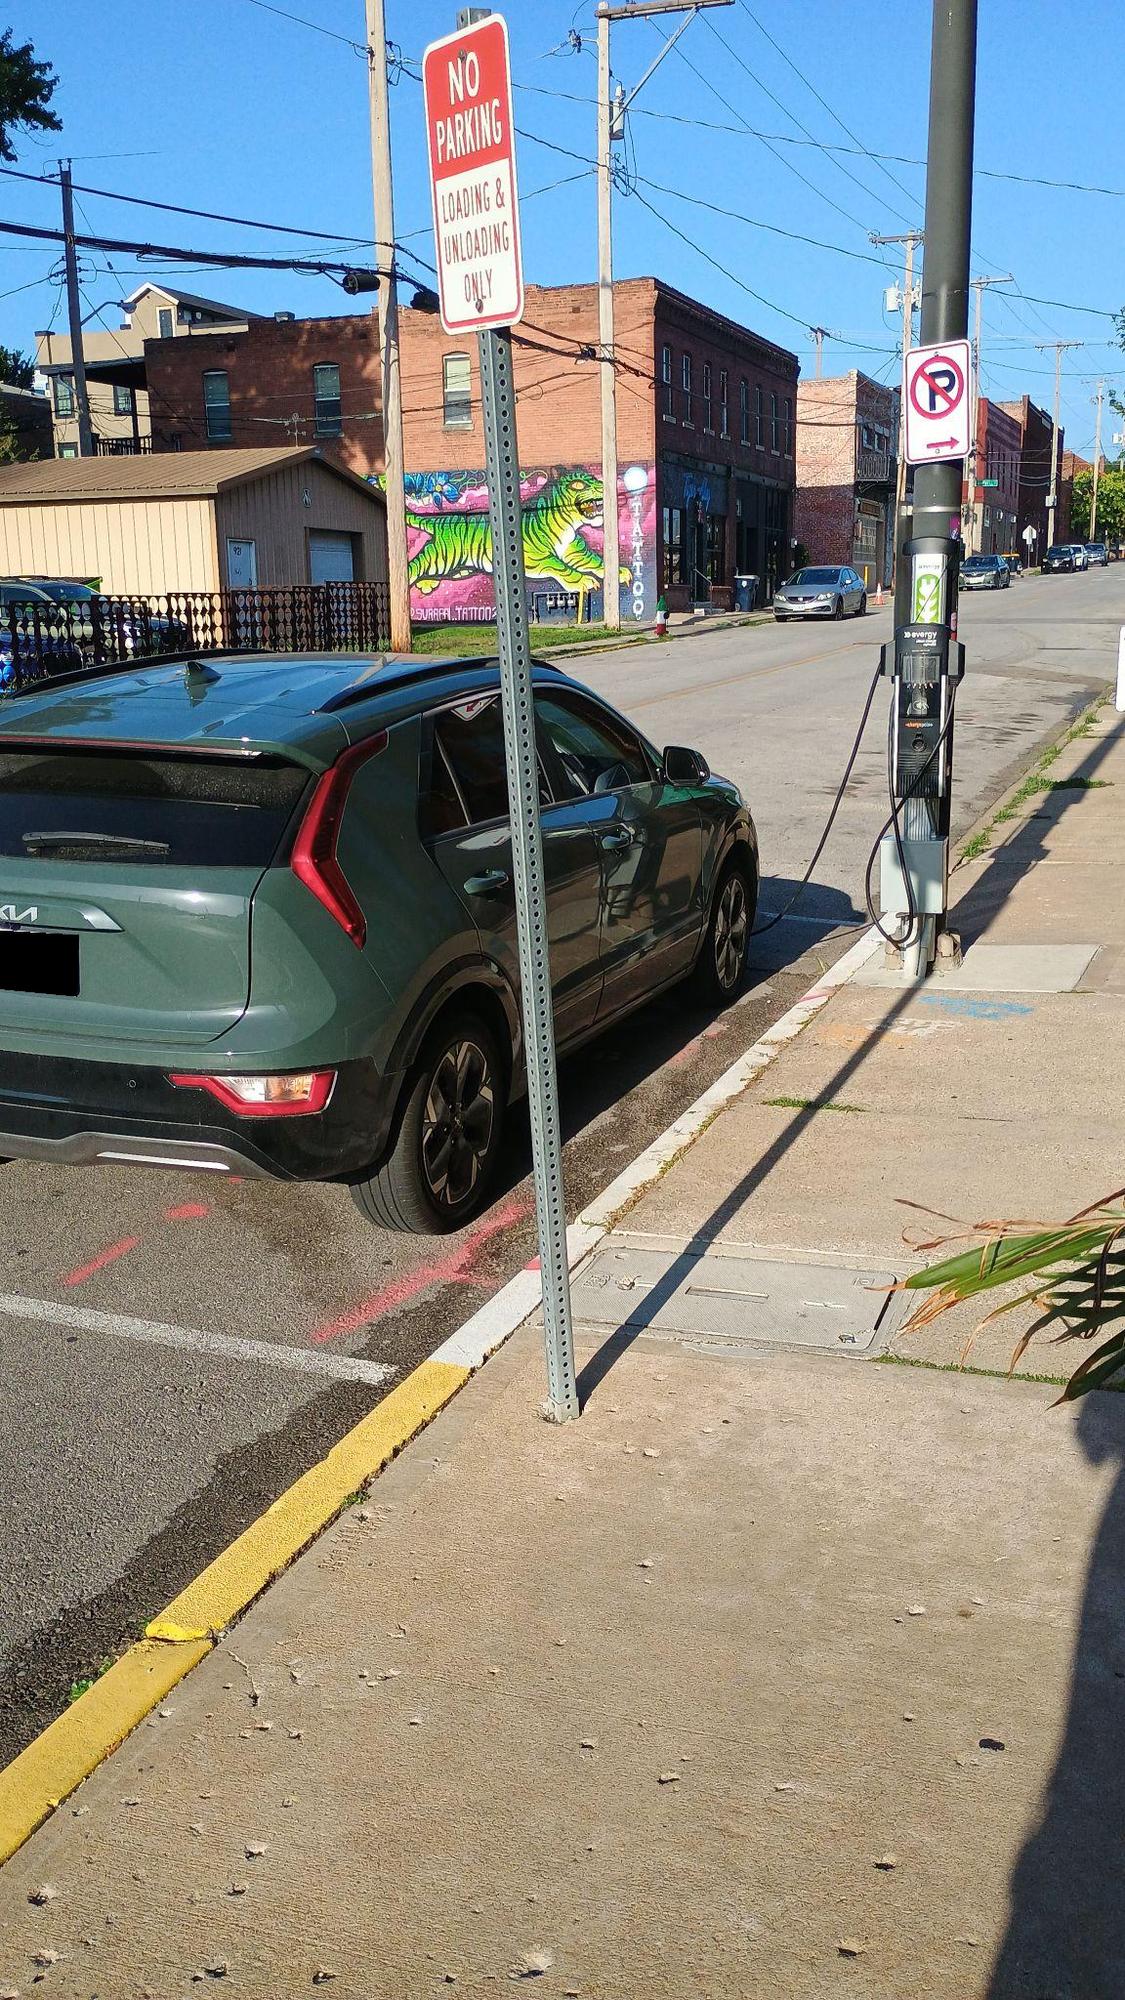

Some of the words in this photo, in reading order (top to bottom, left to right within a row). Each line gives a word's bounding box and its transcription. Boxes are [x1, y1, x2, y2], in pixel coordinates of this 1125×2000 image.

[447, 51, 480, 105] NO
[436, 98, 502, 164] PARKING
[441, 182, 490, 224] LOADING
[496, 177, 505, 207] &
[444, 221, 509, 265] UNLOADING
[464, 268, 493, 303] ONLY
[632, 499, 645, 617] TATTOO
[911, 631, 937, 640] evergy
